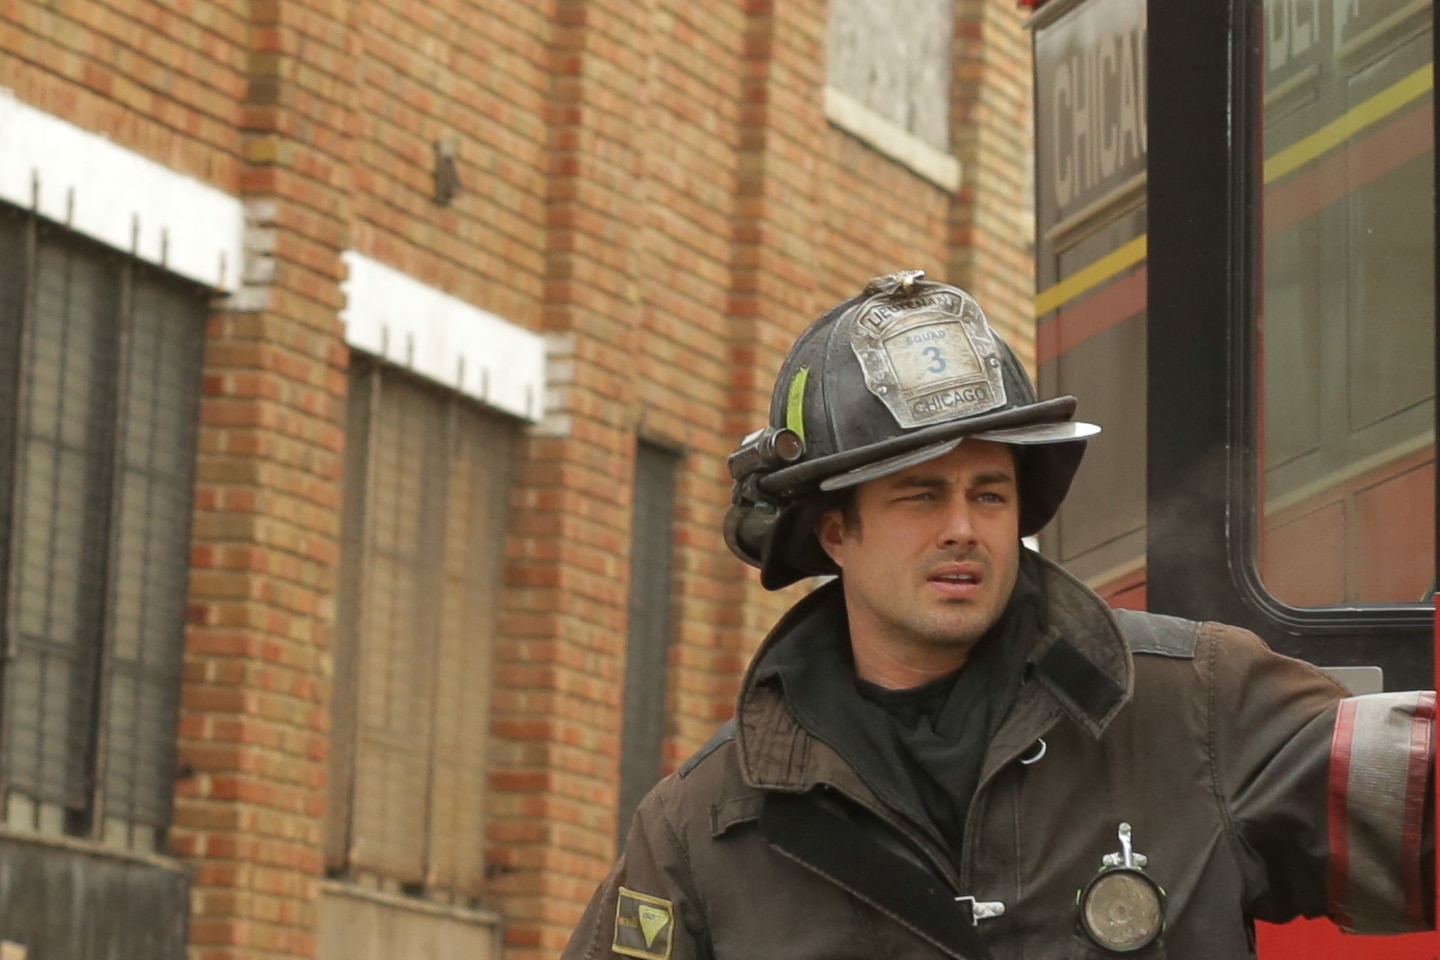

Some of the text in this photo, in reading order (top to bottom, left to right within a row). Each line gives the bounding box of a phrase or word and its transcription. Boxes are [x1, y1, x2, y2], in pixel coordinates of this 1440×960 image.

[906, 330, 947, 346] SQUAD
[922, 346, 947, 374] 3
[913, 387, 988, 415] CHICAGO
